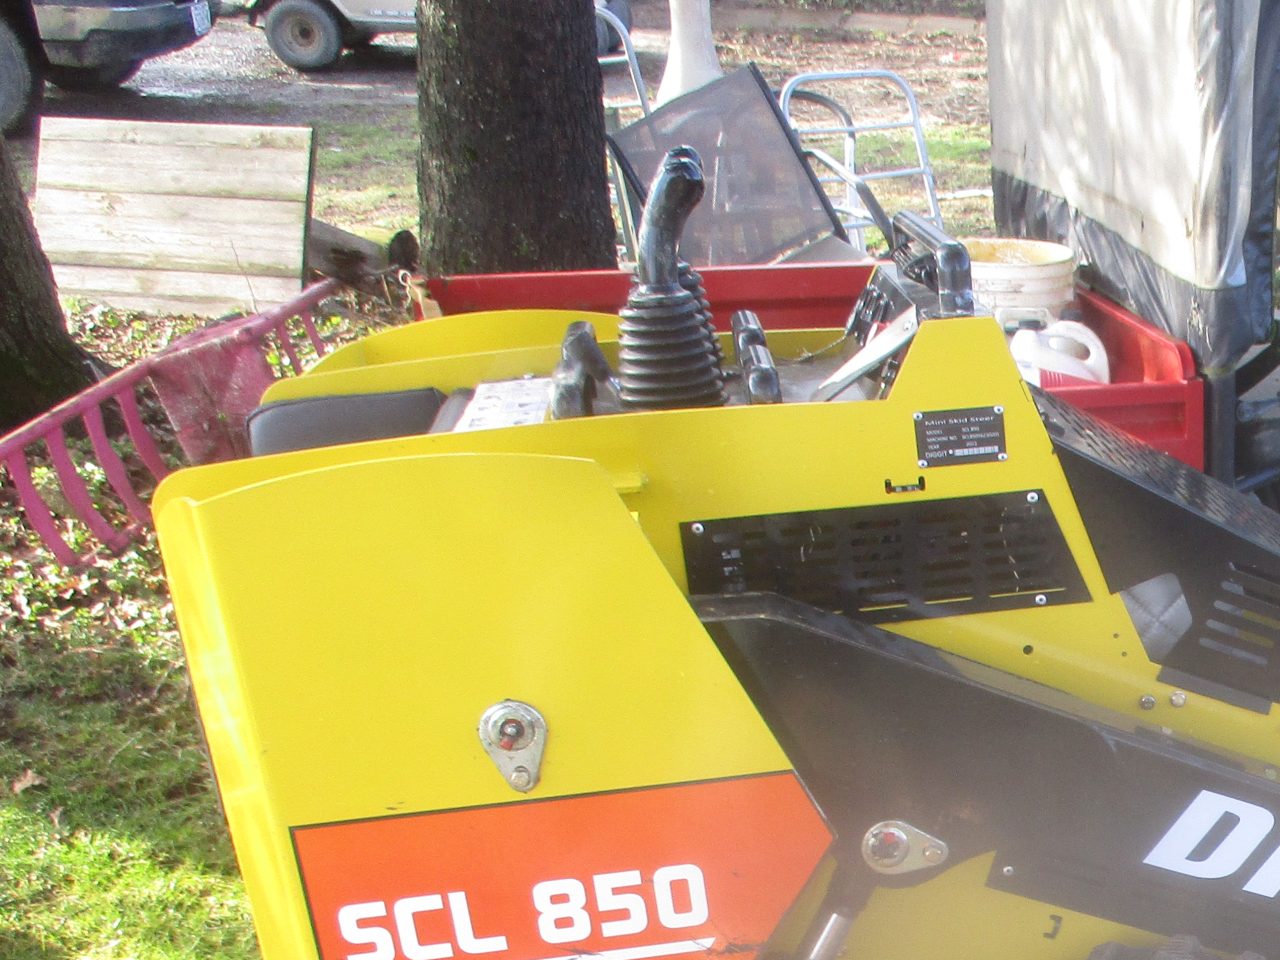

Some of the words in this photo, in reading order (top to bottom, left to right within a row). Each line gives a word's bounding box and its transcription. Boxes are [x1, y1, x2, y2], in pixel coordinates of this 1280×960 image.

[925, 419, 947, 427] Mini
[948, 417, 968, 425] Skid
[970, 415, 994, 423] Steer
[925, 450, 948, 459] DIGGIT
[531, 863, 709, 945] 850
